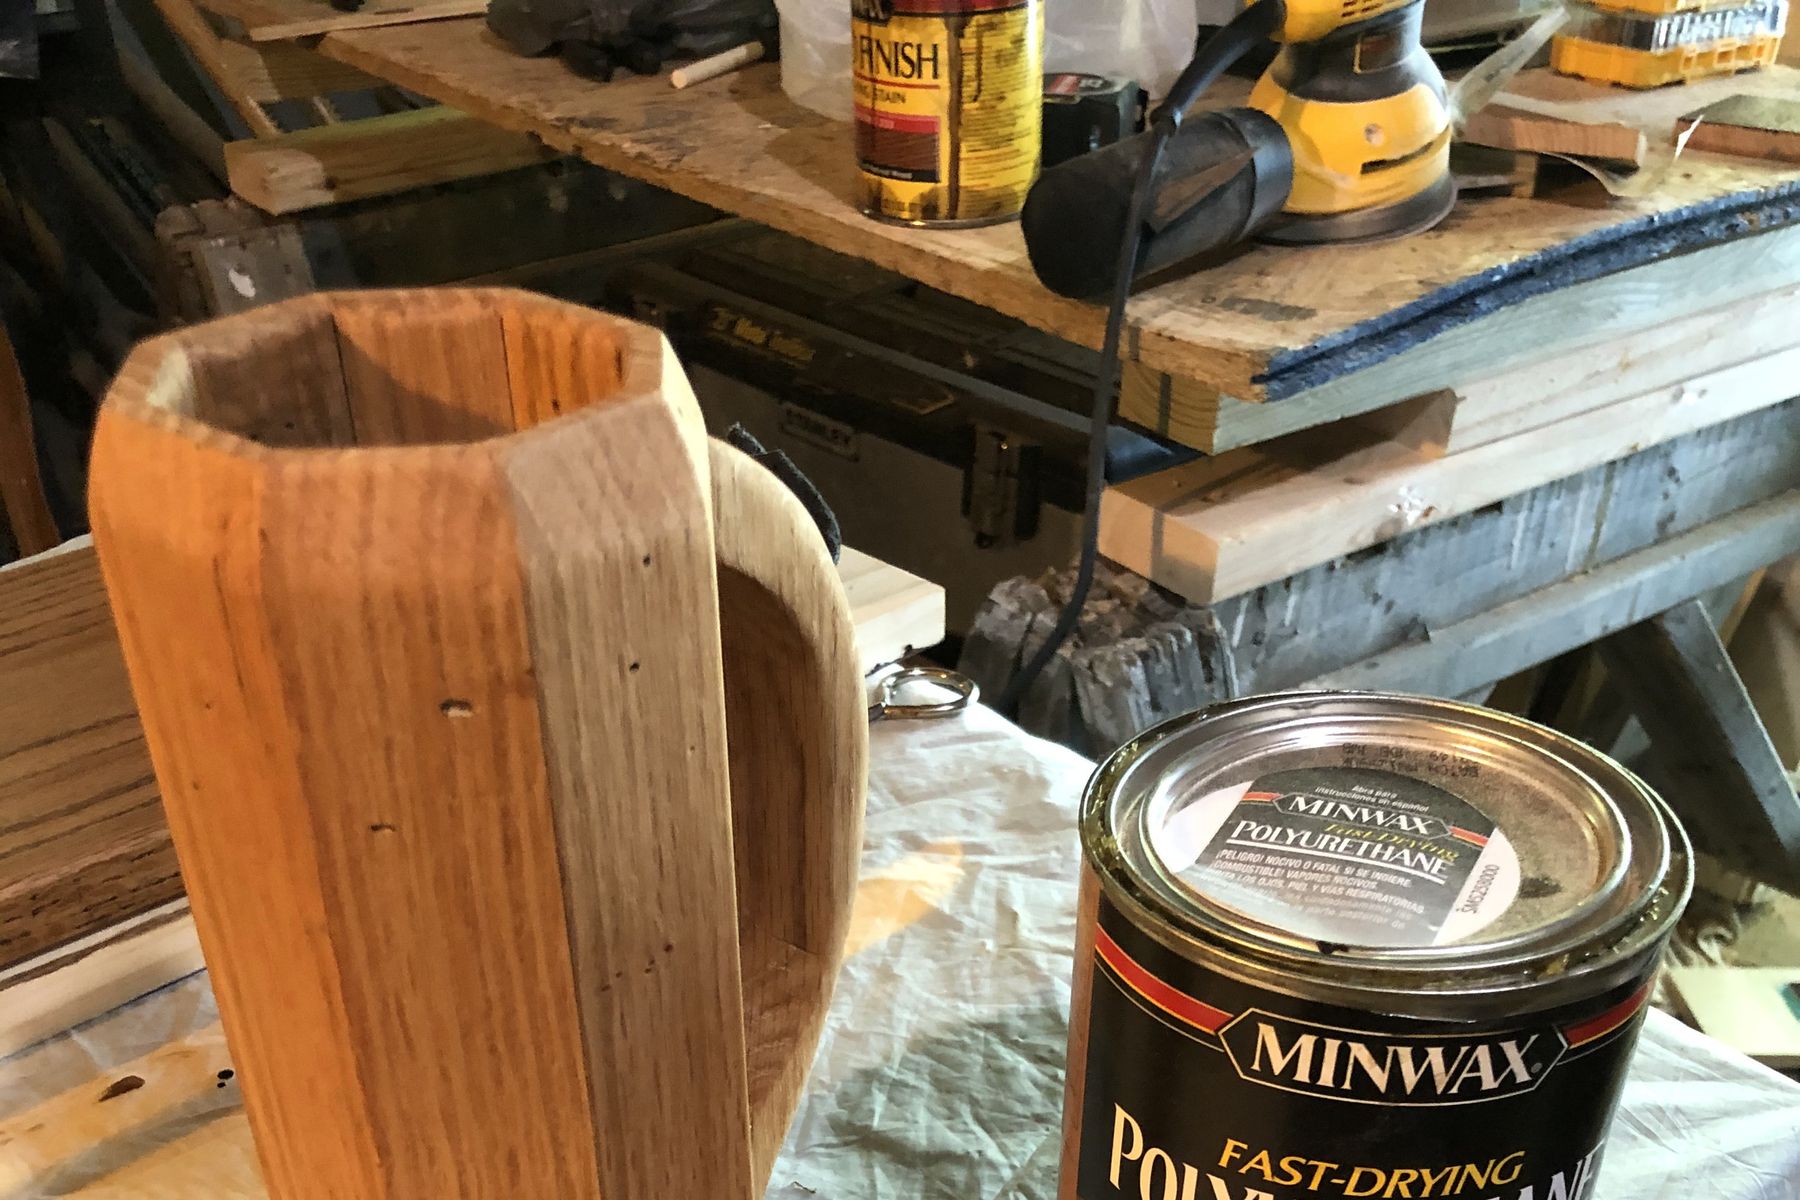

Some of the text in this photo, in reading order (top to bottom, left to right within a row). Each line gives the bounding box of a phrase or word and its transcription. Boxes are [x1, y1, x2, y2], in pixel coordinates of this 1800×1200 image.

[860, 36, 939, 80] FINISH
[1288, 796, 1434, 835] MINWAX
[1231, 819, 1455, 880] POLYURETHANE
[1265, 855, 1302, 870] NOCIVO
[1312, 862, 1342, 875] FATAL
[1286, 869, 1331, 884] VAPORES
[1250, 1022, 1540, 1095] MINWAX
[1218, 1138, 1526, 1199] FAST-DRYING
